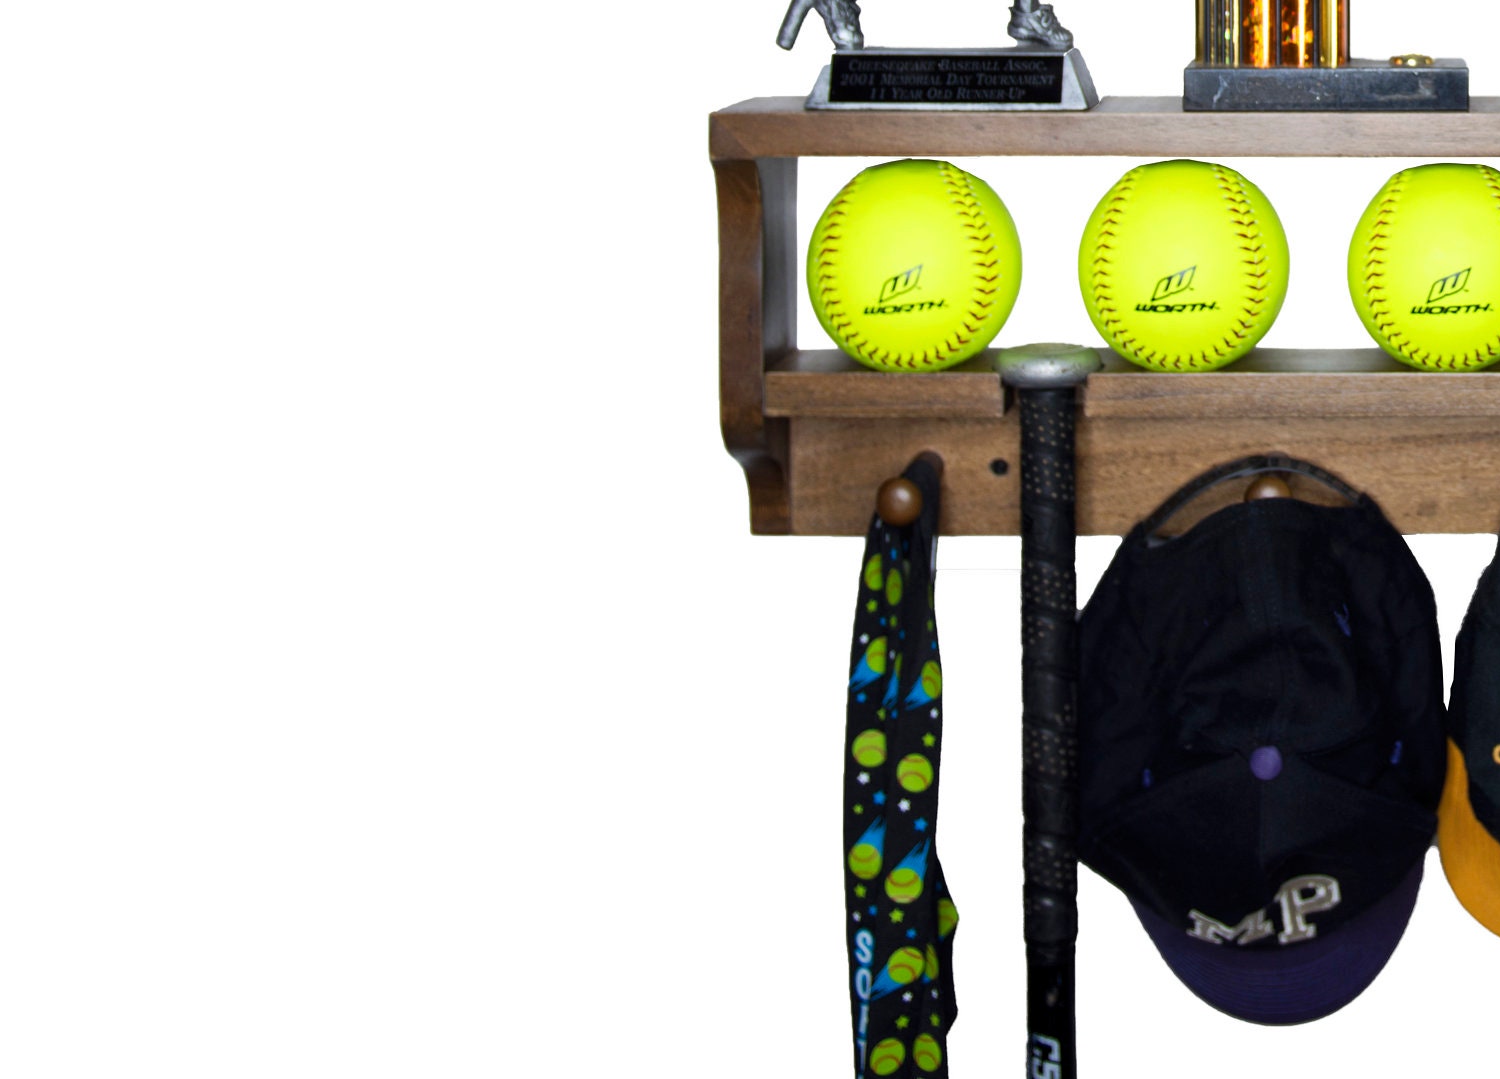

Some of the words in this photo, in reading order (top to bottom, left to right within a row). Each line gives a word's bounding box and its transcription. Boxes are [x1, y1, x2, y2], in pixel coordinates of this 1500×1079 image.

[940, 59, 1002, 71] BASEBALL
[1004, 59, 1048, 71] ASSOC.
[840, 73, 875, 86] 2001
[880, 73, 942, 86] MEMORIAL
[946, 73, 973, 86] DAY
[977, 73, 1056, 86] TOURNAMENT
[892, 87, 924, 100] YEAR
[927, 87, 953, 99] OLD
[864, 299, 945, 314] WORTH
[1135, 301, 1217, 313] WORTH
[1411, 303, 1490, 315] WORTH
[1186, 874, 1342, 945] MP
